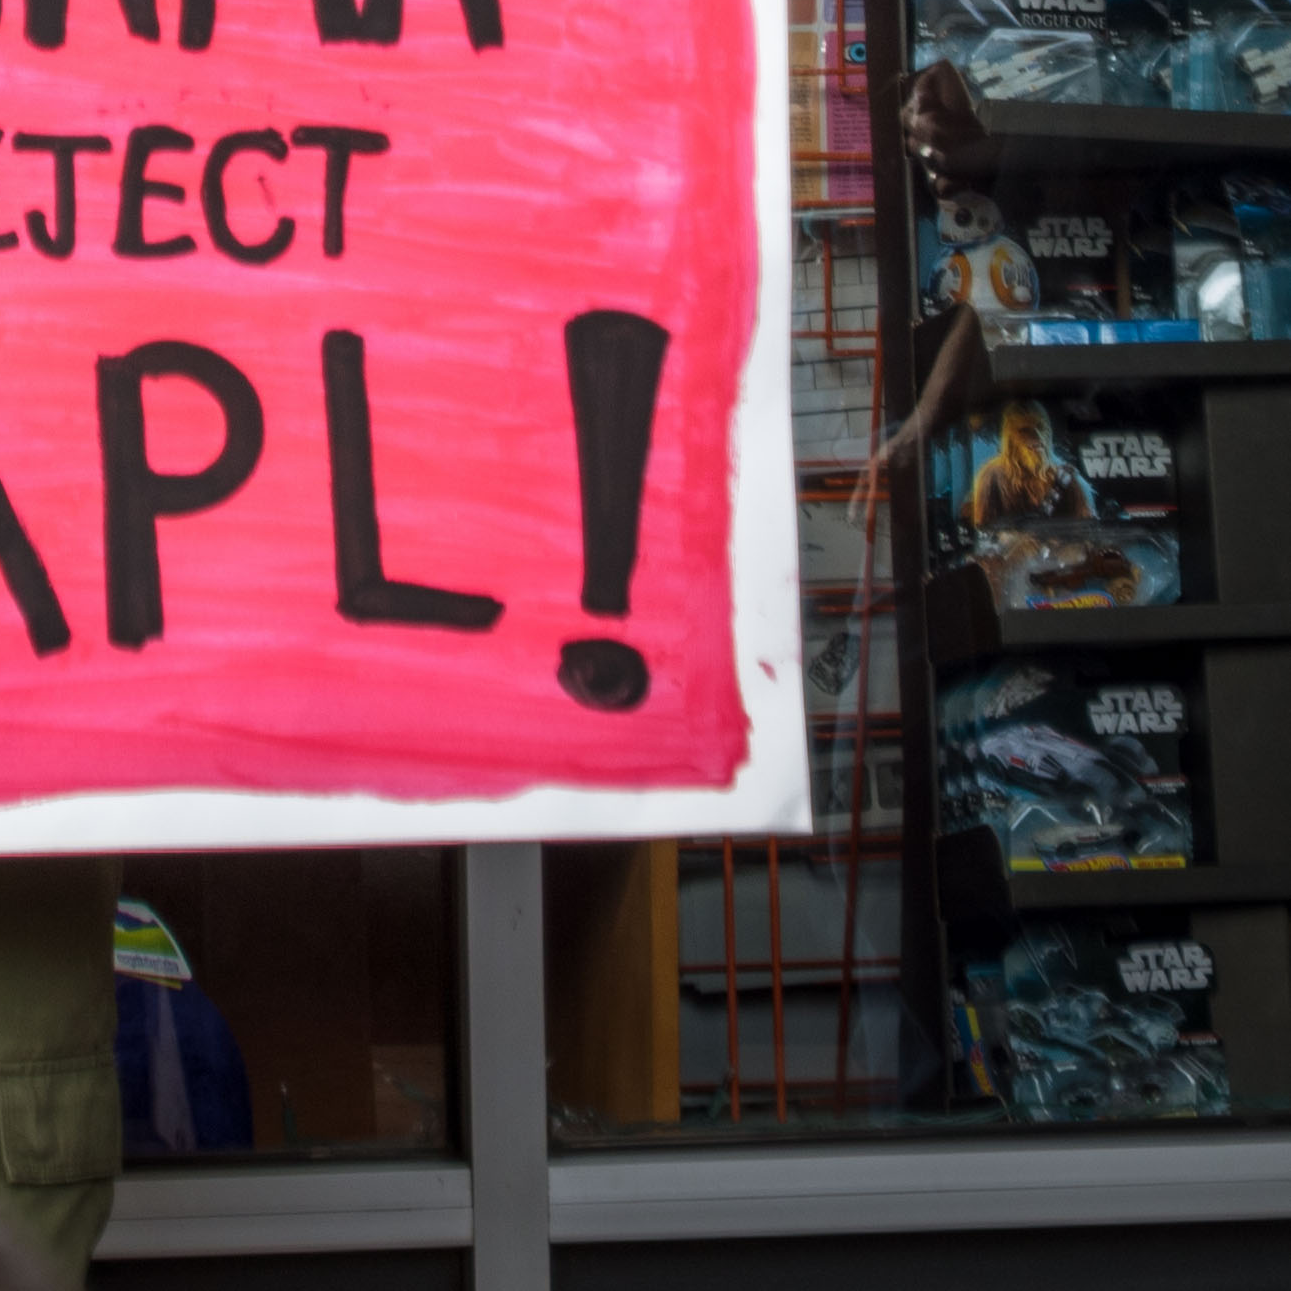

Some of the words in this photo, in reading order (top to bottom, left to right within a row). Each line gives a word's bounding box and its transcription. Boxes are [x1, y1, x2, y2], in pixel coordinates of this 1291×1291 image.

[1021, 12, 1073, 28] ROGUE
[1075, 13, 1107, 30] ONE
[1027, 215, 1114, 239] STAR
[1028, 236, 1114, 259] WARS
[1079, 434, 1173, 459] STAR
[1080, 455, 1173, 479] WARS
[1086, 687, 1183, 714] STAR
[1088, 711, 1183, 736] WARS
[1118, 942, 1214, 972] STAR
[1120, 967, 1214, 994] WARS
